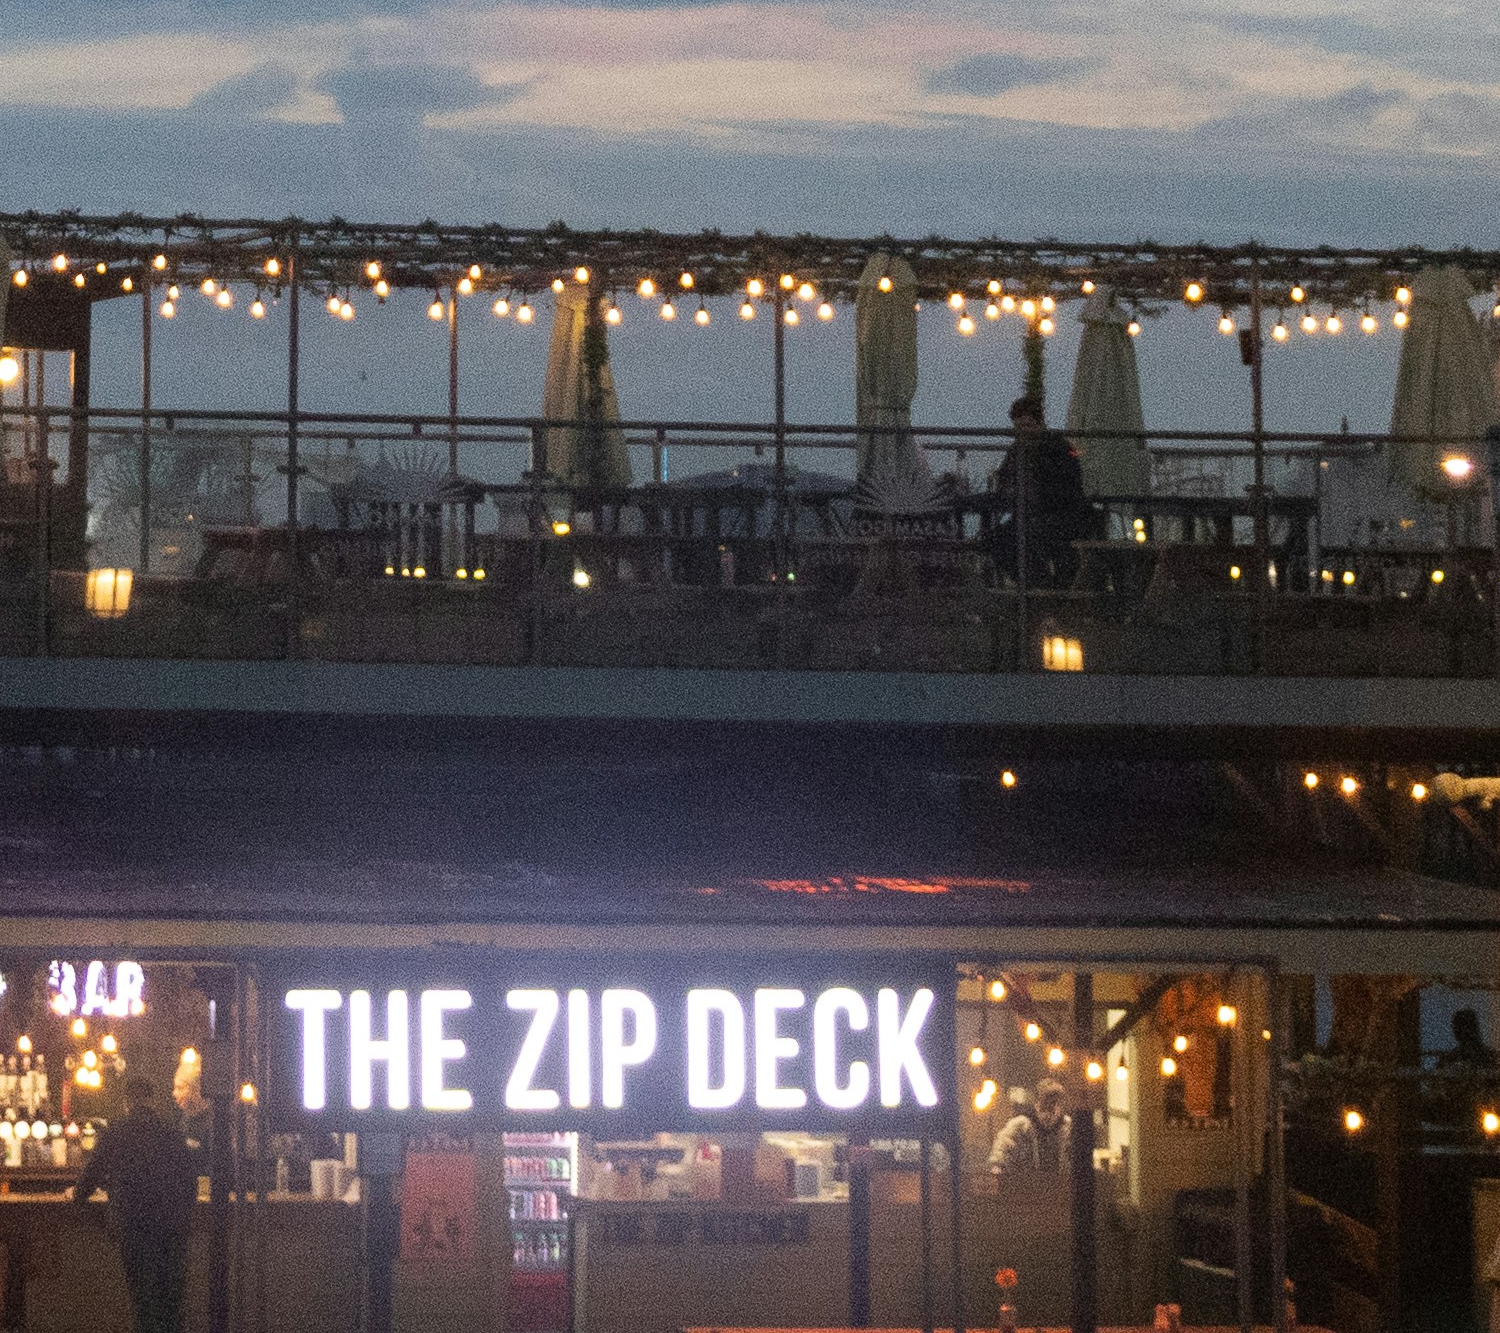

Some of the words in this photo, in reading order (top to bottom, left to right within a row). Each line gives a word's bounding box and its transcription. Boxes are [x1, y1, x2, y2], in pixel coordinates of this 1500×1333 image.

[48, 959, 146, 1017] BAR
[284, 988, 474, 1110] THE
[504, 988, 658, 1110] ZIP
[687, 988, 939, 1109] DECK
